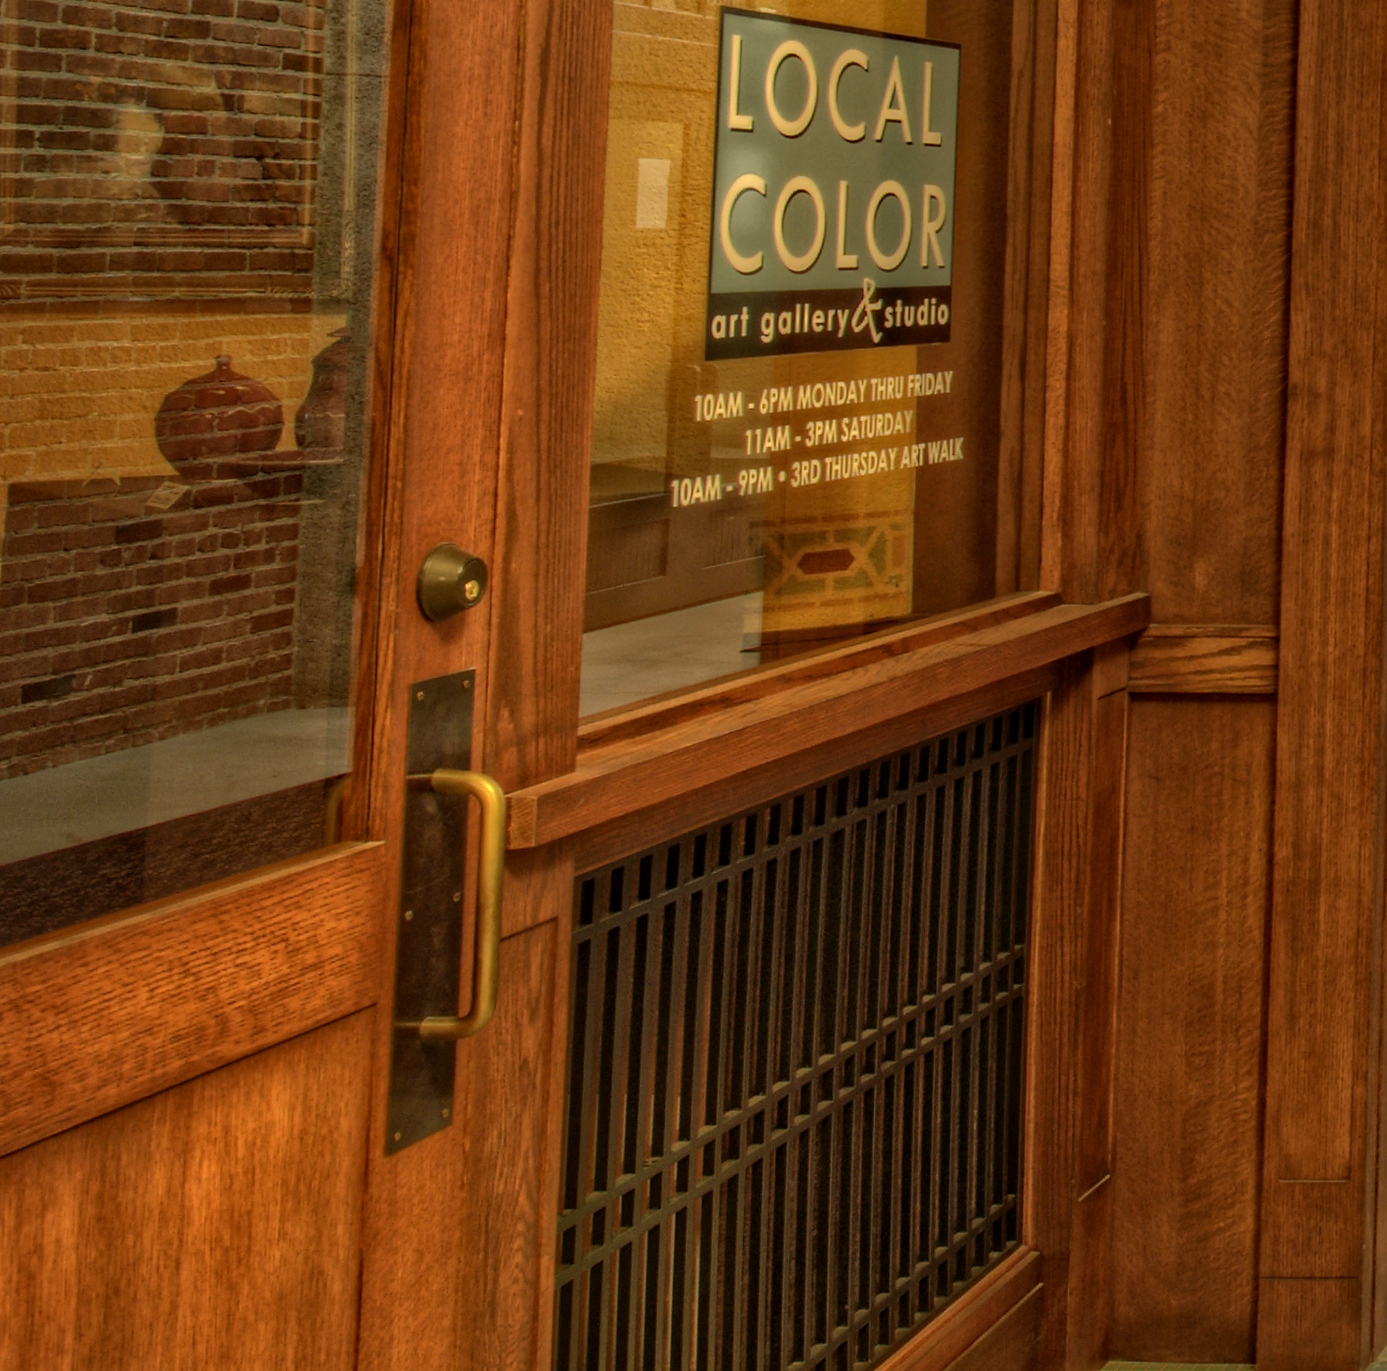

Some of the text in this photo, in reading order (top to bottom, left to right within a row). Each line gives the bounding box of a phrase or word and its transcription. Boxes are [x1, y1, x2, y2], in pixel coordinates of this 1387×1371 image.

[728, 34, 942, 145] LOCAL
[720, 173, 946, 273] COLOR
[711, 306, 749, 339] art
[760, 303, 849, 343] gallery
[884, 298, 949, 328] studio
[694, 391, 743, 422] 10AM
[759, 386, 793, 414] 6PM
[796, 379, 867, 410] MONDAY
[870, 376, 904, 401] THRU
[907, 370, 953, 398] FRIDAY
[745, 425, 791, 455] 11AM
[805, 419, 838, 447] 3PM
[840, 410, 913, 442] SATURDAY
[670, 474, 722, 507] 10AM
[738, 466, 774, 496] 9PM
[790, 459, 822, 488] 3RD
[824, 447, 898, 482] THURSDAY
[900, 443, 926, 469] ART
[927, 437, 964, 465] WALK
